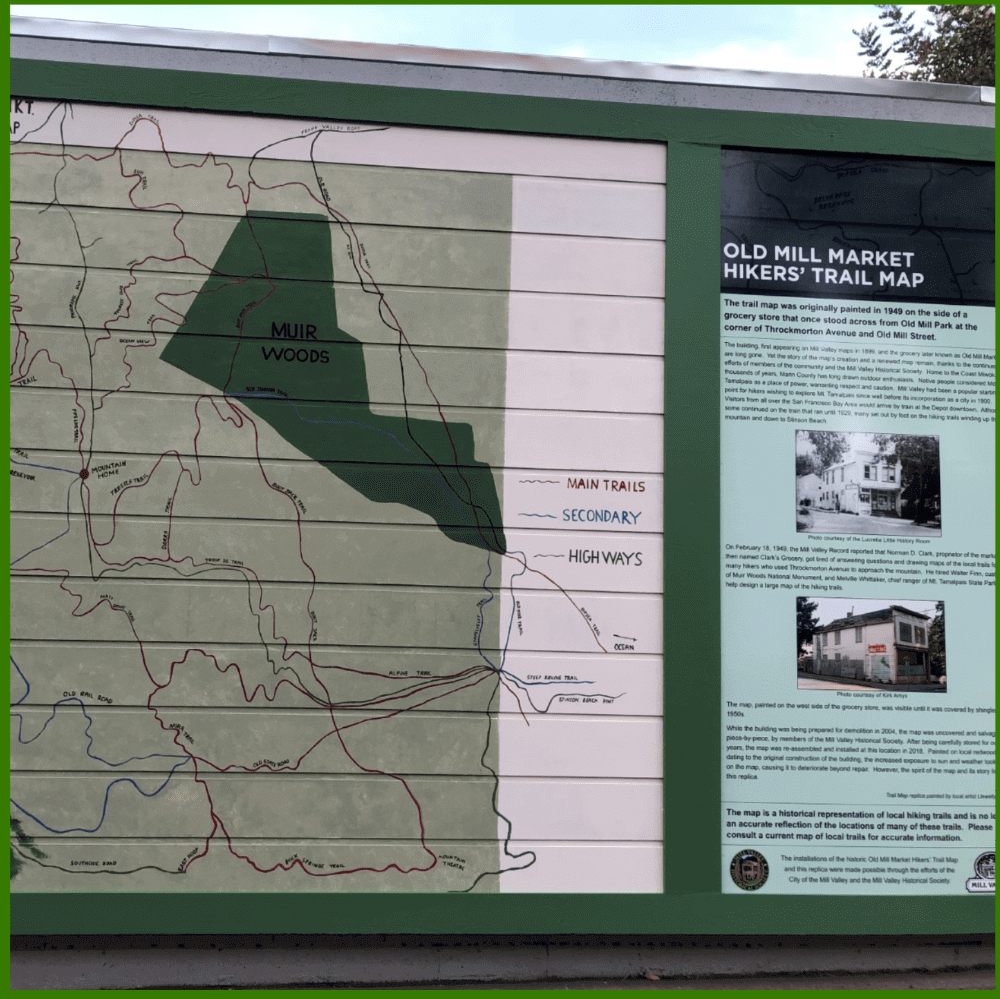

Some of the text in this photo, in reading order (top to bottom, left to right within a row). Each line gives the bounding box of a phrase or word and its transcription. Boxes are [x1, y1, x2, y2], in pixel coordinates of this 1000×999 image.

[723, 243, 914, 268] OLD MILL MARKET
[811, 268, 872, 285] TRAIL
[880, 271, 924, 287] MAP
[724, 299, 739, 307] The
[761, 302, 778, 310] map
[800, 304, 838, 313] originally
[840, 305, 871, 314] painted
[724, 312, 756, 321] grocery
[759, 313, 780, 321] store
[901, 320, 915, 328] Old
[955, 322, 963, 330] at
[965, 323, 978, 331] the
[271, 322, 317, 340] MUIR
[765, 325, 823, 335] Throckmorton
[826, 329, 856, 337] Avenue
[910, 332, 937, 340] Street.
[261, 346, 330, 364] WOODS
[91, 461, 127, 474] MOUNTAIN
[97, 469, 120, 479] HOME
[133, 473, 149, 484] TRAIL
[567, 477, 646, 492] MAIN TRAILS
[296, 500, 308, 515] TRAIL
[562, 508, 642, 525] SECONDARY
[614, 643, 635, 651] OCEAN
[79, 691, 94, 699] RAIL
[97, 695, 113, 704] ROAD
[169, 723, 195, 745] NORA TRAIL
[817, 810, 874, 819] representation
[886, 811, 905, 819] local
[907, 812, 931, 821] hiking
